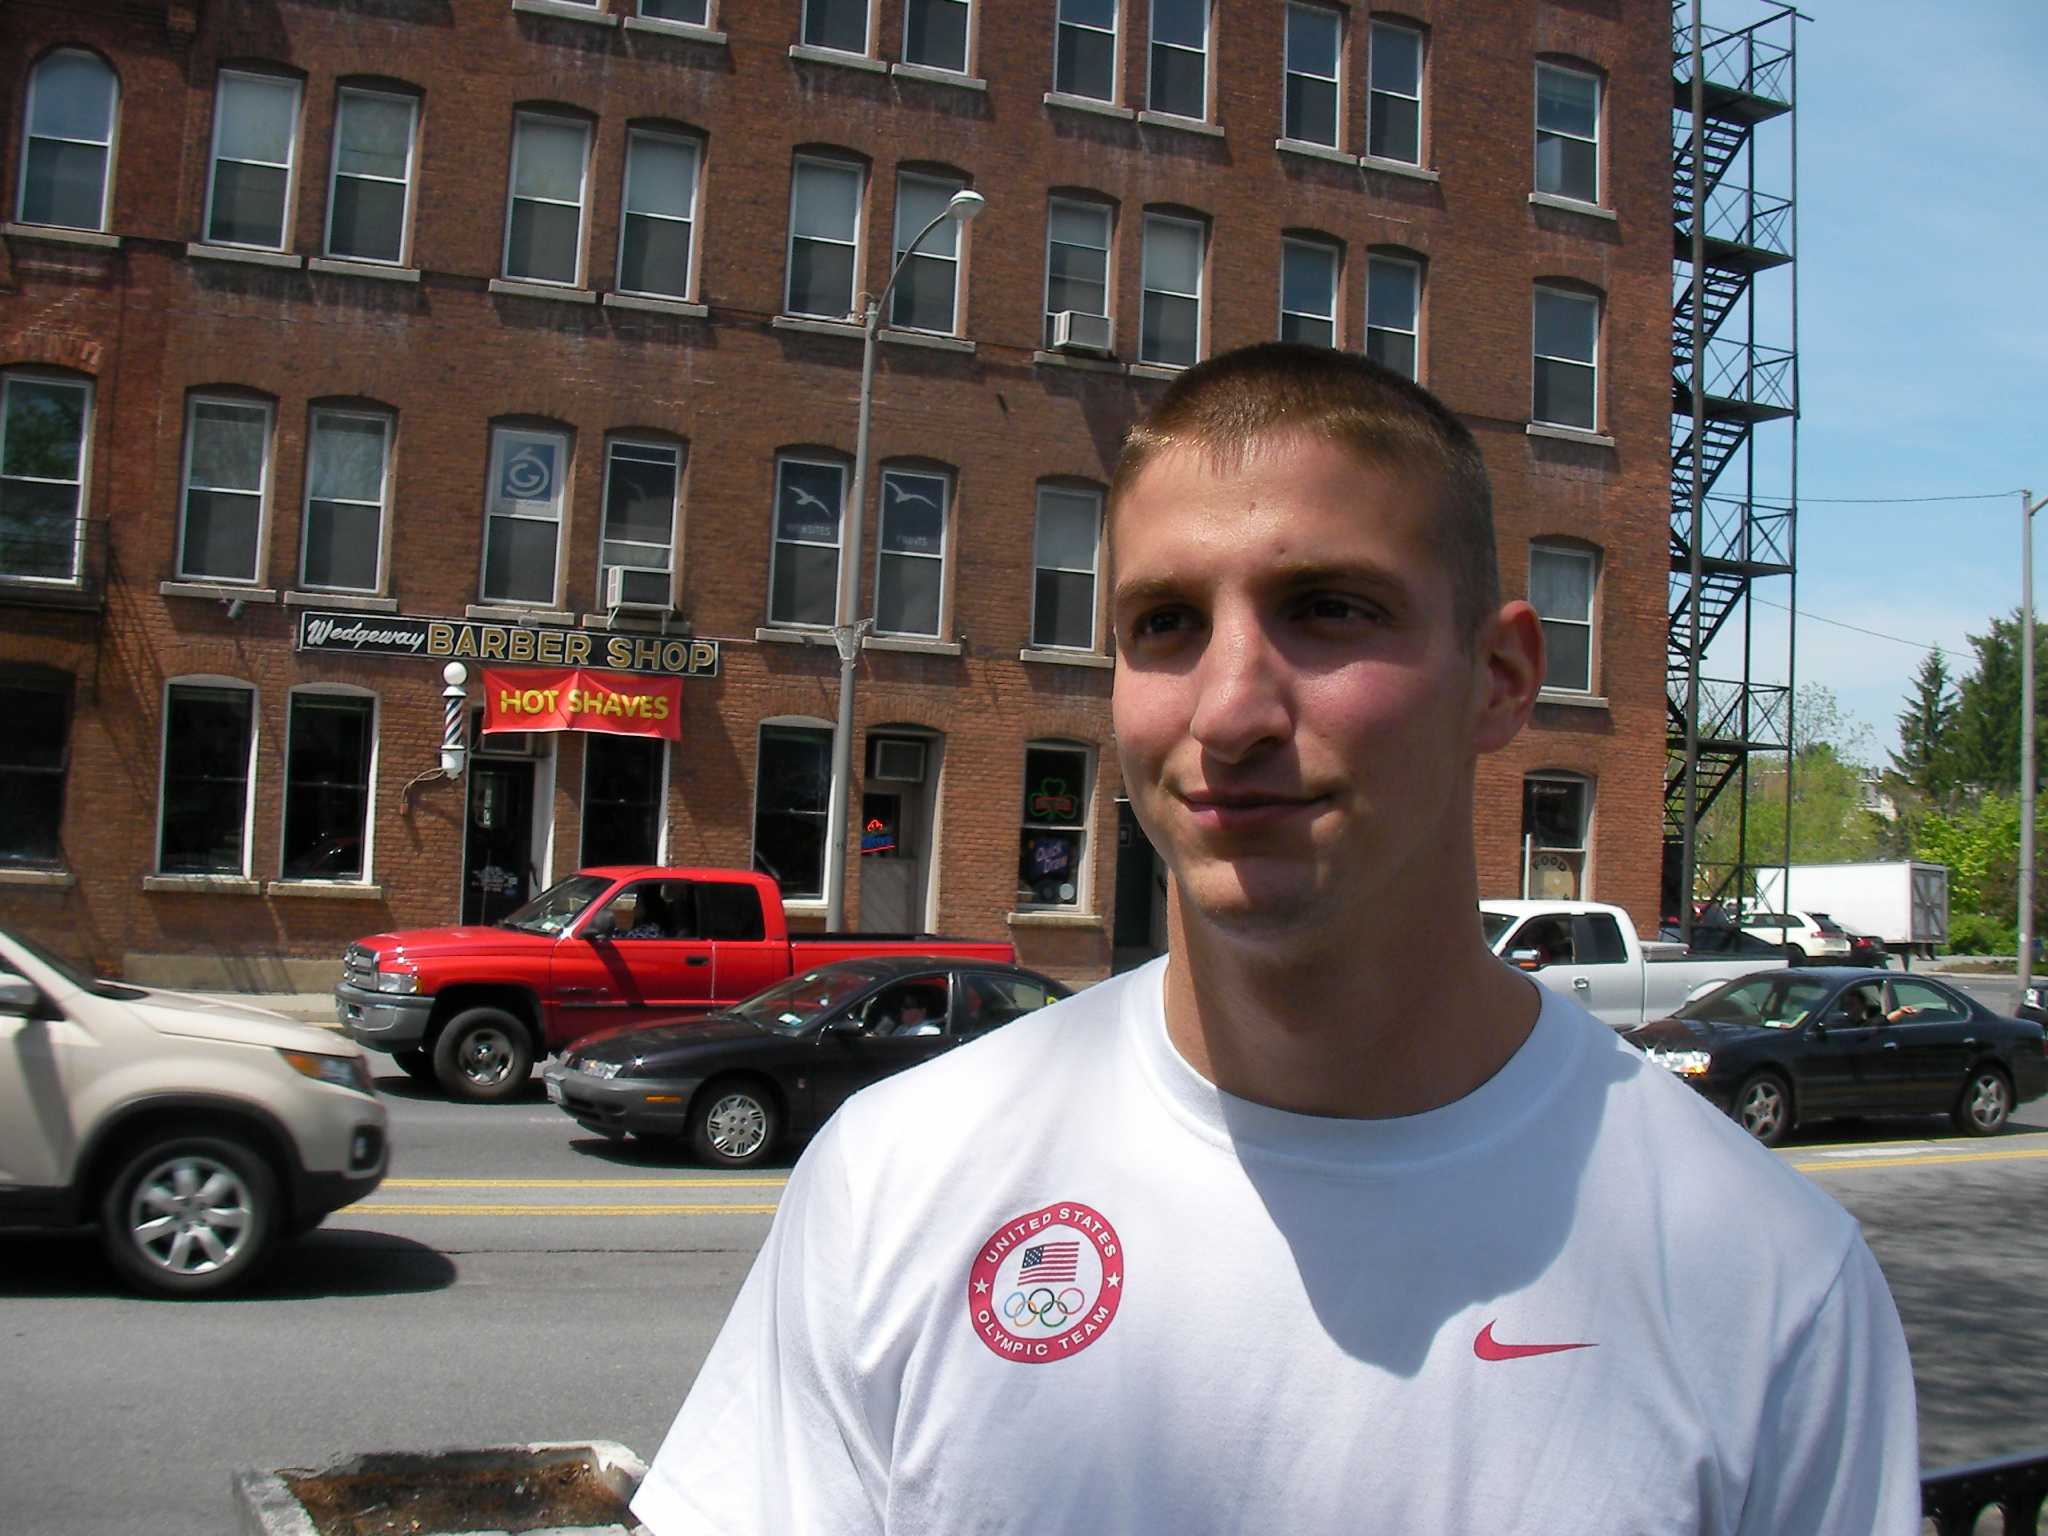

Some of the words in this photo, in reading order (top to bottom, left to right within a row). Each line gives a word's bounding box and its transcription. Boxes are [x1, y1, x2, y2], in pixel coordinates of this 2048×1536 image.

[307, 619, 424, 652] Wedgeway
[427, 624, 592, 665] BARBER
[606, 637, 715, 673] SHOP
[500, 689, 560, 714] HOT
[567, 688, 669, 720] SHAVES
[1532, 855, 1567, 872] FOOD
[985, 1212, 1052, 1264] UNITED
[1058, 1207, 1117, 1259] STATES
[977, 1309, 1049, 1357] OLYMPIC
[1057, 1305, 1110, 1351] TEAM
